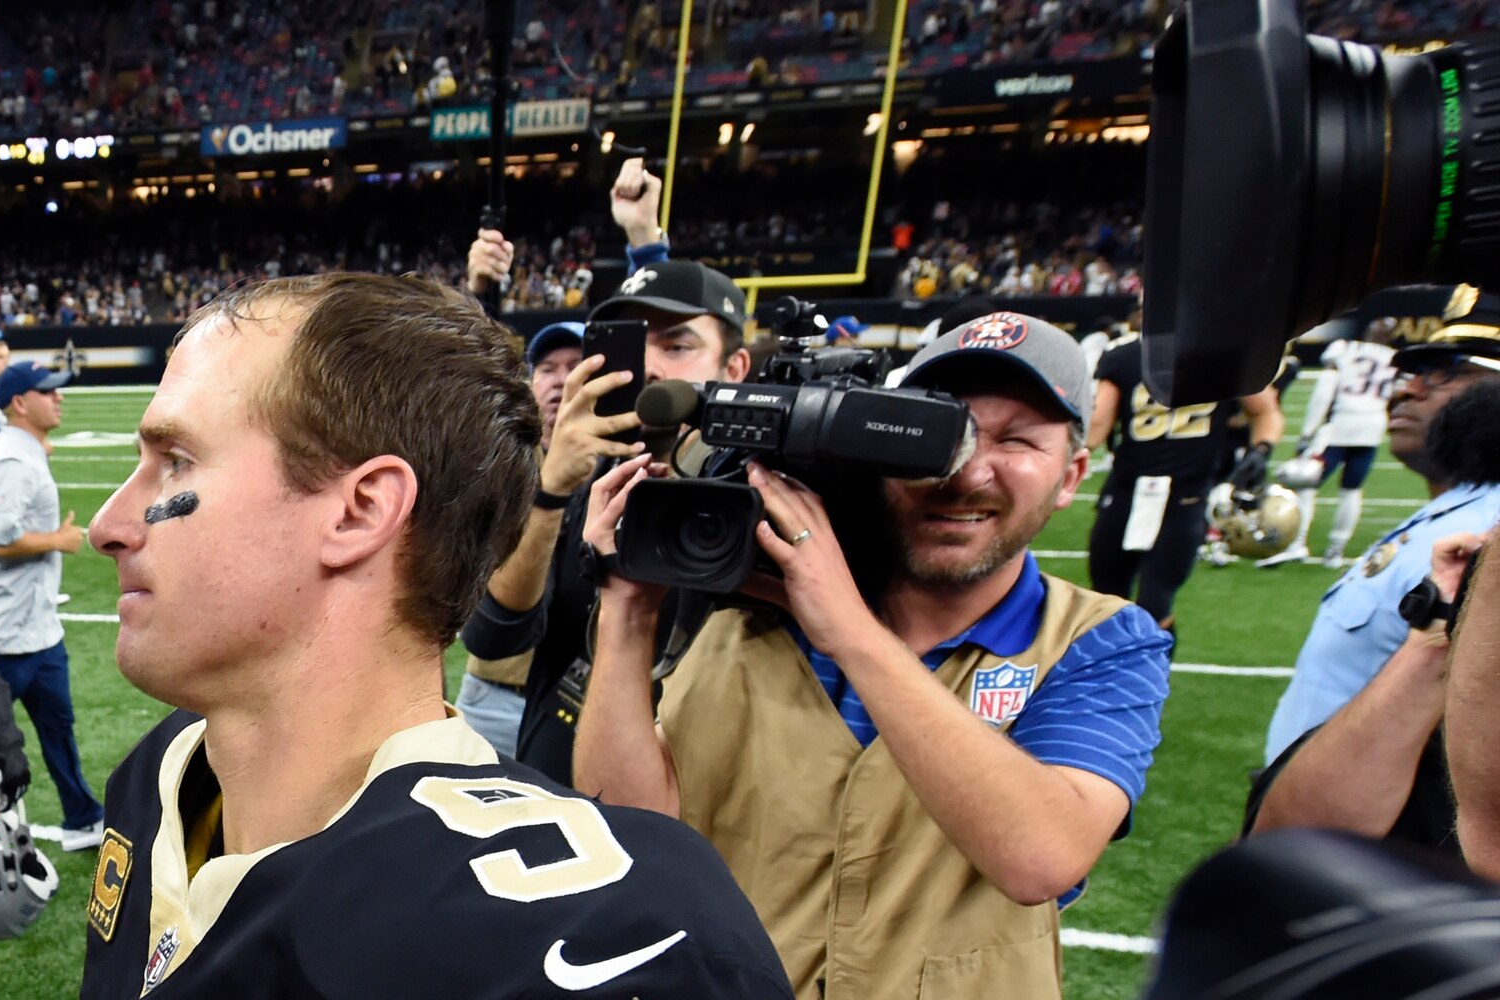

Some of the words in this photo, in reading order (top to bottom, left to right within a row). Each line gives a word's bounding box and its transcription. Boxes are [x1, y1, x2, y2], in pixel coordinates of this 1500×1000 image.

[1442, 97, 1461, 133] ZOOM
[228, 123, 336, 155] Ochsner
[1443, 137, 1460, 157] TV
[1439, 160, 1460, 198] WIDE
[747, 393, 781, 403] SONY
[864, 420, 904, 434] XDCAM
[906, 426, 924, 436] HD
[978, 690, 1022, 720] NFL
[409, 775, 634, 903] 9
[94, 838, 129, 911] C
